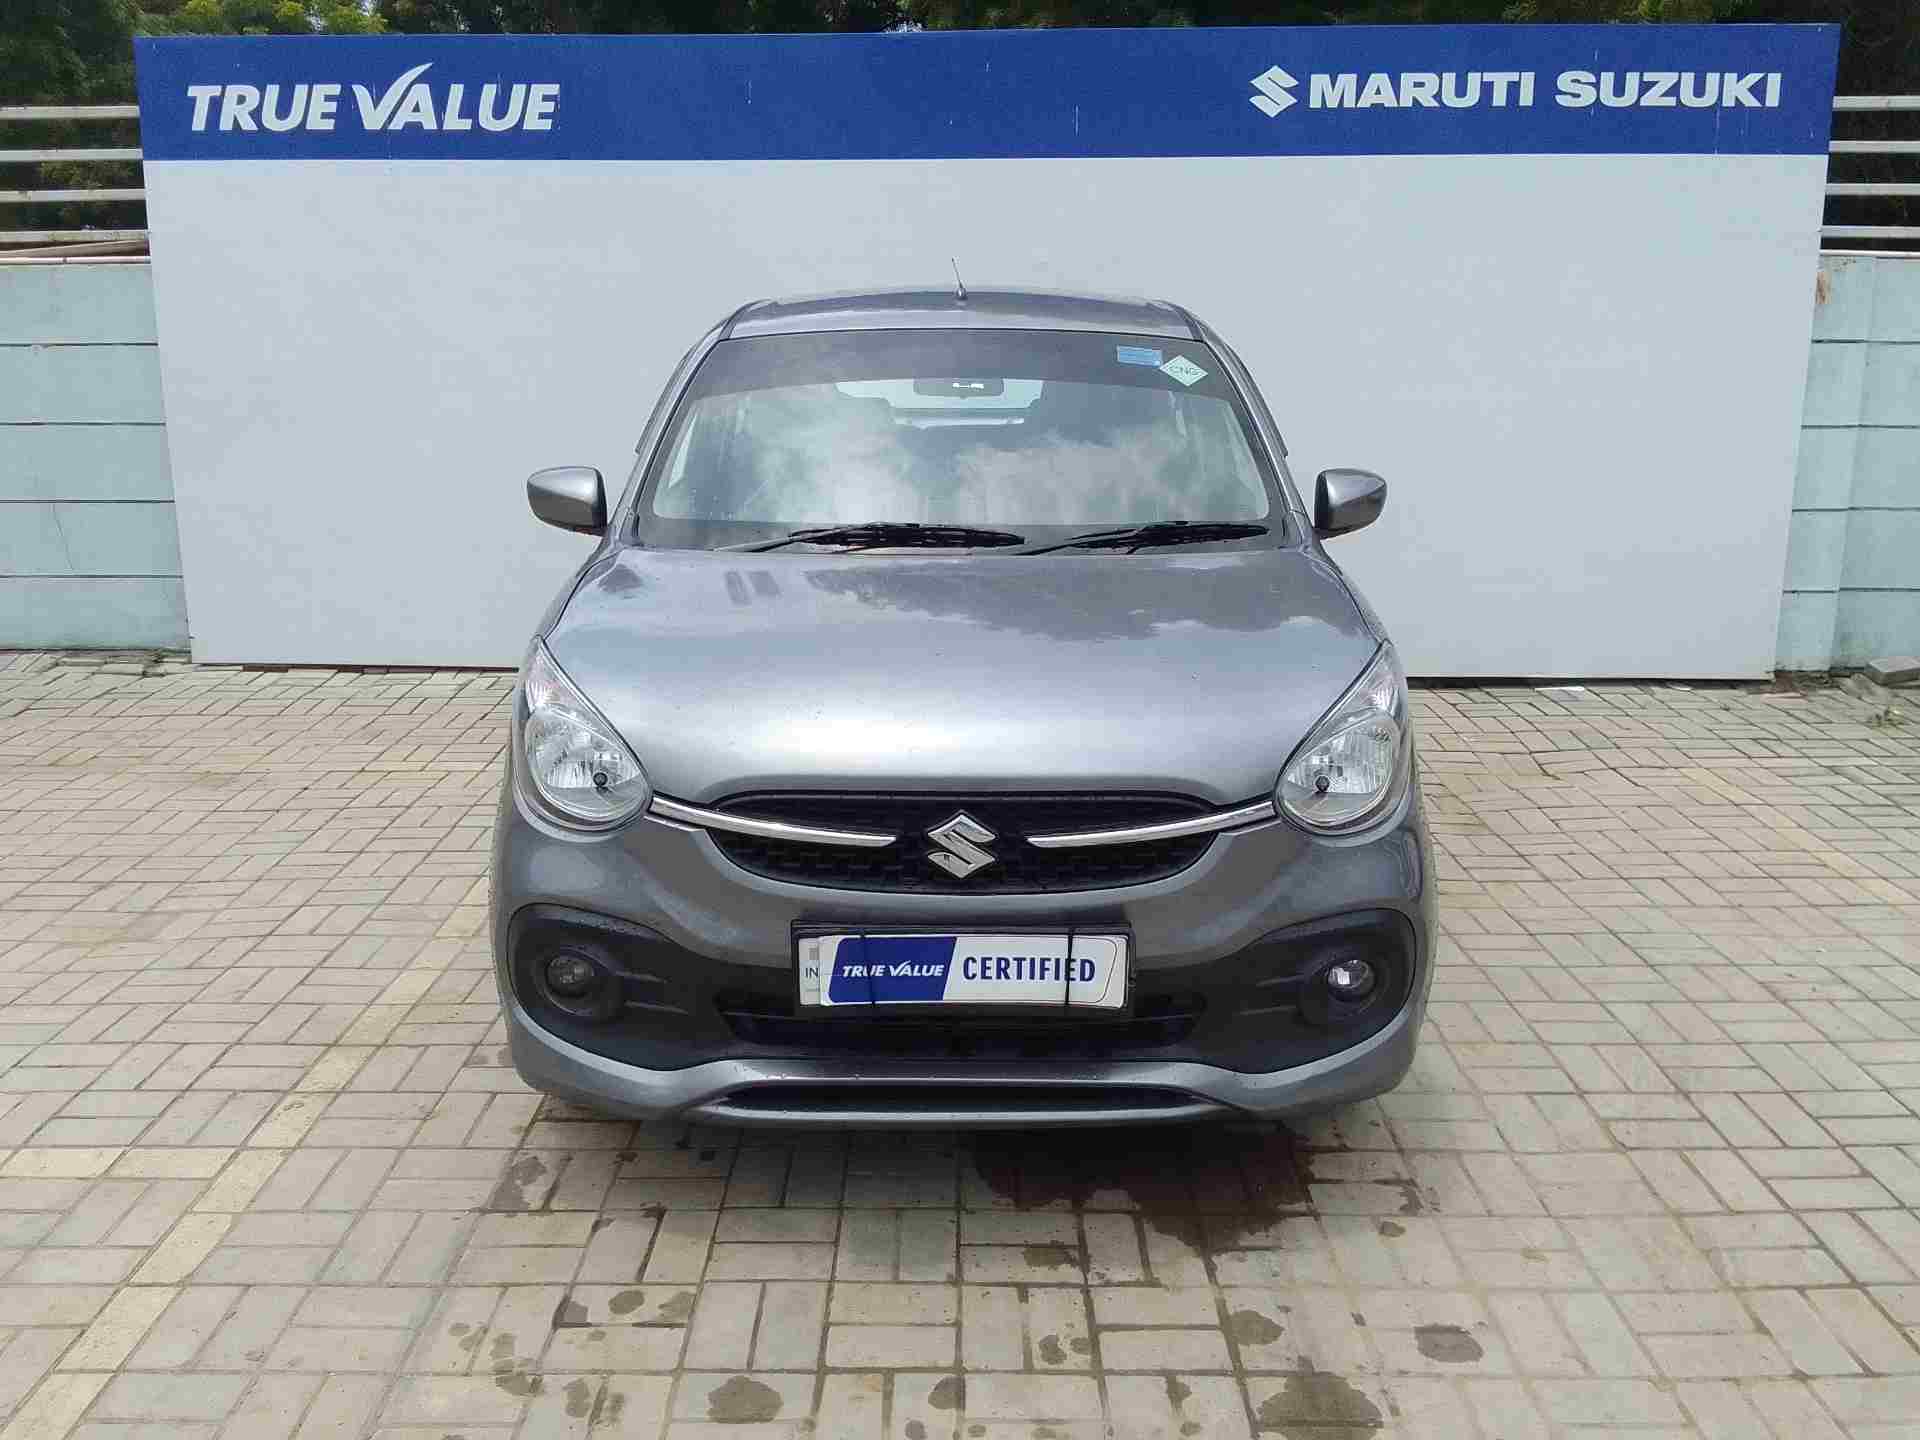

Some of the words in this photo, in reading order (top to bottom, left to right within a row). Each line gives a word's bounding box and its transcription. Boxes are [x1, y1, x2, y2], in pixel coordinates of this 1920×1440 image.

[187, 83, 341, 132] TRUE
[352, 62, 561, 132] VALUE
[1309, 72, 1535, 108] MARUTI
[1555, 70, 1782, 108] SUZUKI
[842, 964, 886, 977] TRUE
[889, 960, 945, 977] VALUE
[963, 956, 1095, 982] CERTIFIED
